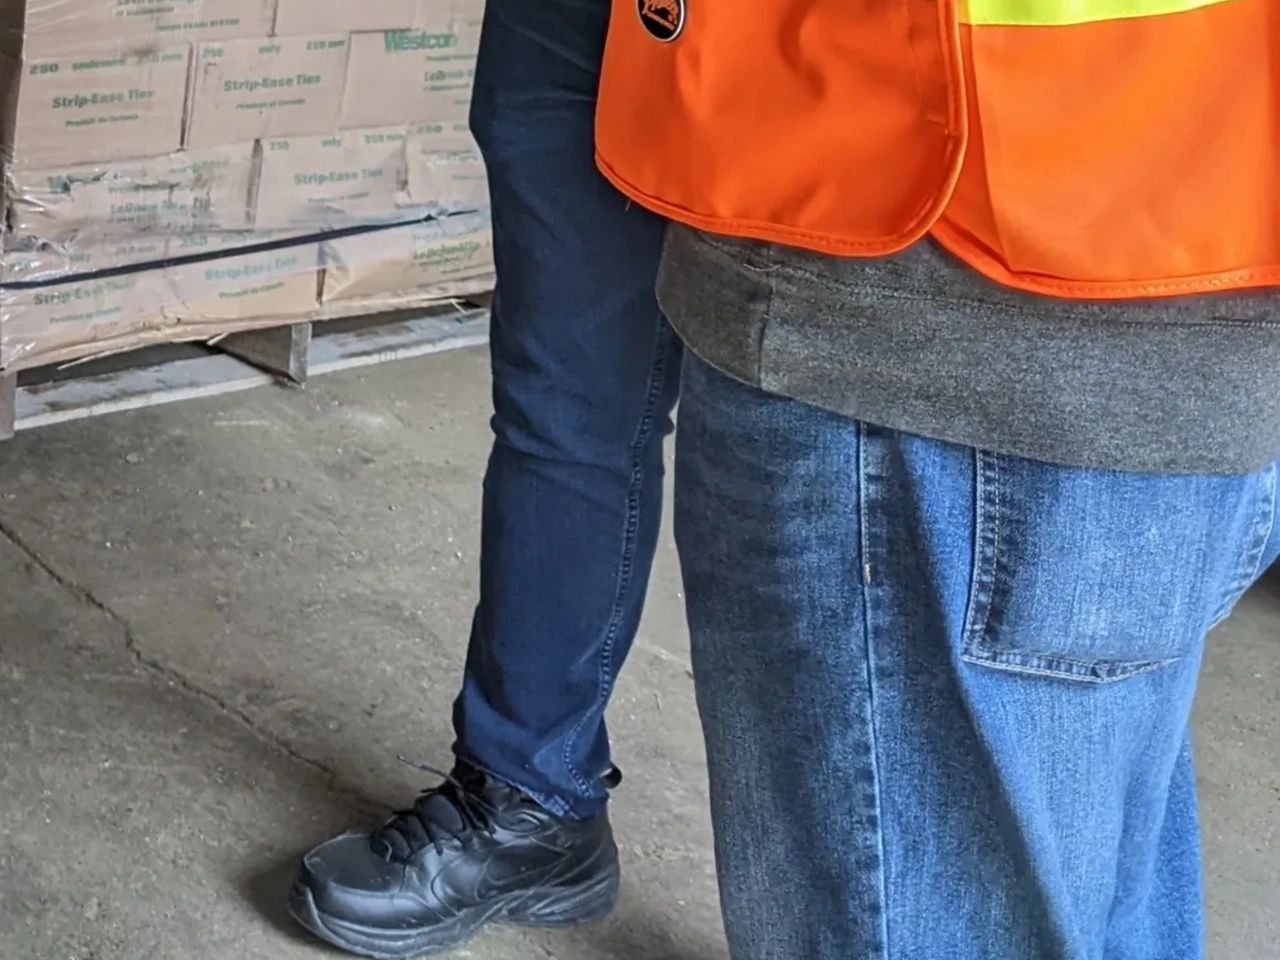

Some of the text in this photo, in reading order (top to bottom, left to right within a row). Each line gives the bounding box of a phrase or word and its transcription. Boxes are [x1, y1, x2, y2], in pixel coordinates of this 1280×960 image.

[384, 30, 458, 54] Westcon
[29, 63, 59, 75] 250
[224, 74, 322, 92] Strip-Ease Ties
[52, 89, 155, 109] Strip-Ease Ties
[294, 171, 359, 186] Strip-Ease
